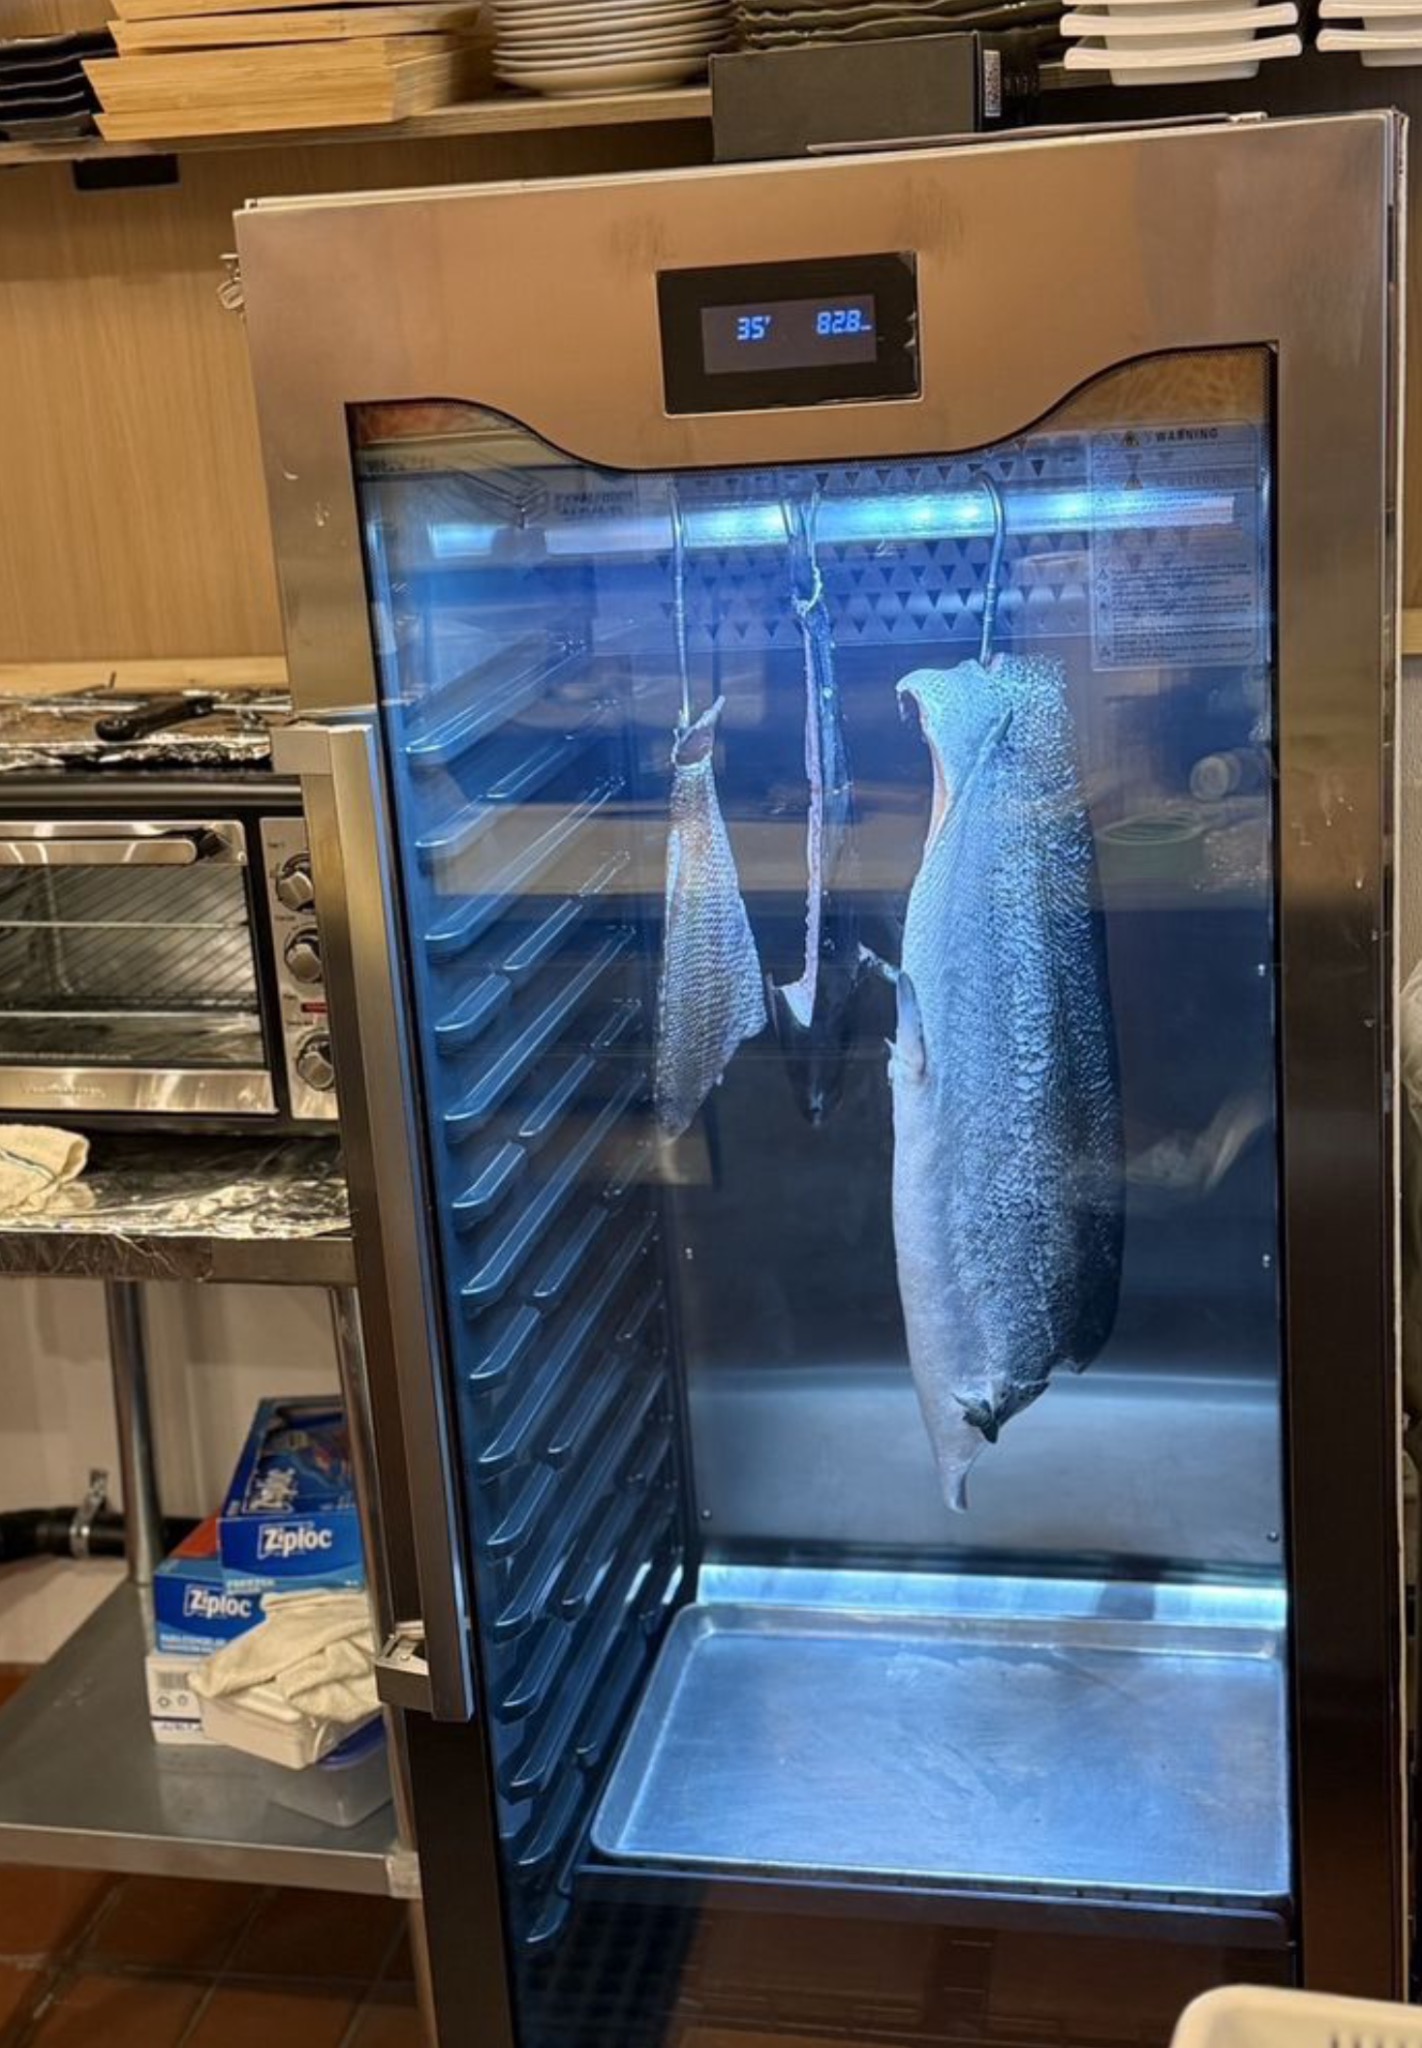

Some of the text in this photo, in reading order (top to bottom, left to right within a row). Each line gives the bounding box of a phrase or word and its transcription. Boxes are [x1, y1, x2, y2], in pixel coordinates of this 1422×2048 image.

[1156, 427, 1219, 442] WARNING
[264, 1528, 332, 1557] Ziploc
[190, 1589, 252, 1618] Ziploc
